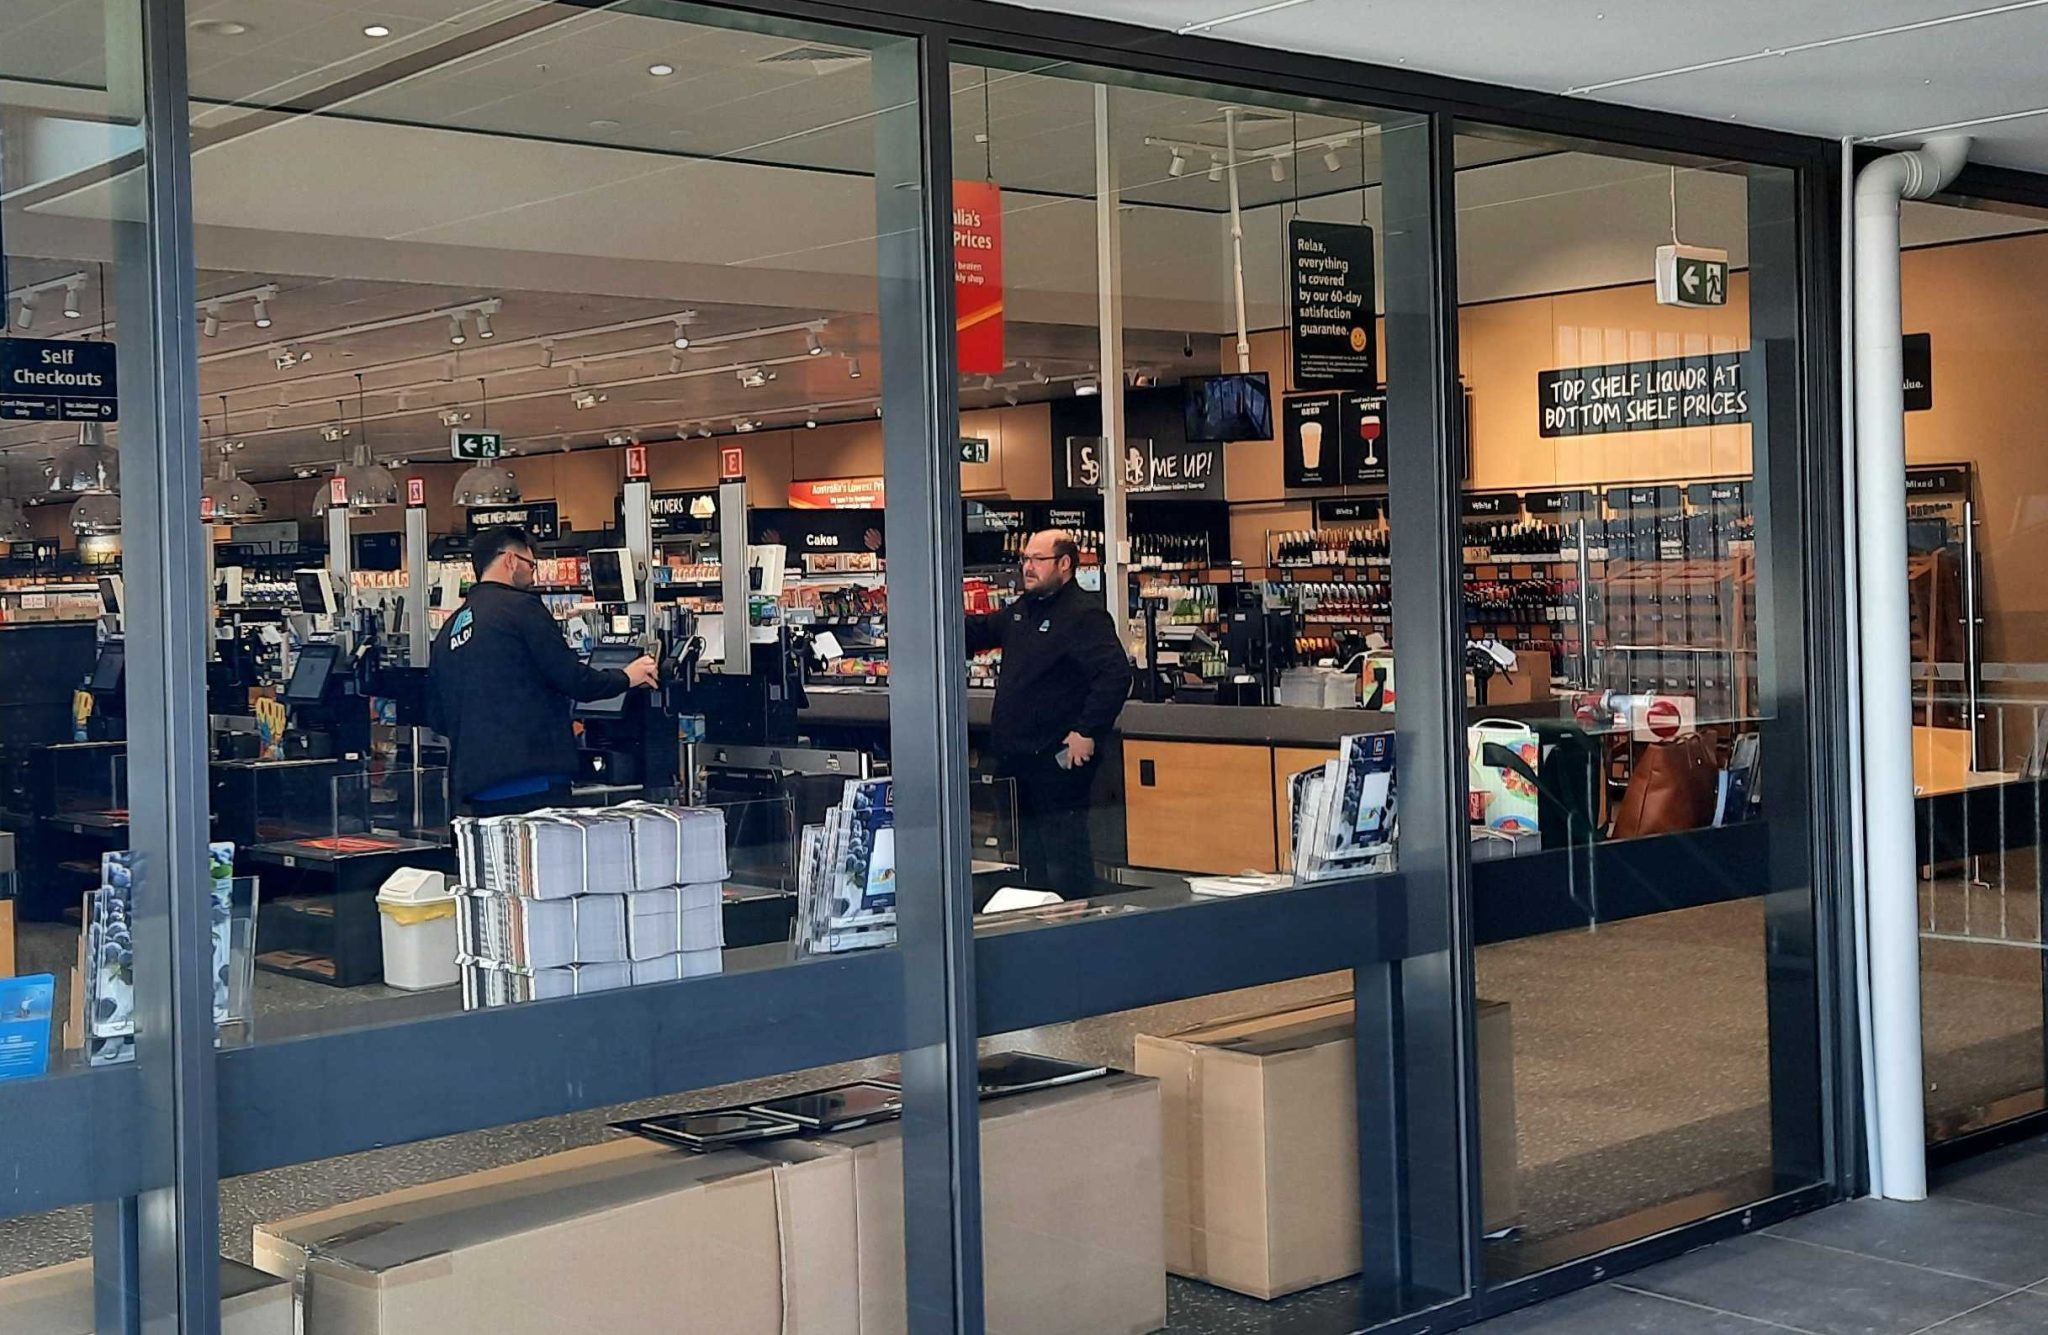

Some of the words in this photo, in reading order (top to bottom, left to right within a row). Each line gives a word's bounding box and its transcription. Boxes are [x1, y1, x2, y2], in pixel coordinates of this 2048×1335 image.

[953, 230, 992, 249] Prices
[1297, 238, 1327, 254] Relax,
[1298, 256, 1349, 273] everything
[967, 274, 985, 286] shop
[1298, 270, 1306, 284] is
[1308, 273, 1345, 286] covered
[1299, 287, 1311, 304] by
[1312, 292, 1329, 302] our
[1330, 290, 1362, 307] 60-day
[1299, 305, 1351, 319] satisfaction
[1300, 324, 1350, 337] guarantee.
[41, 348, 75, 365] Self
[13, 368, 103, 387] Checkouts
[1550, 380, 1585, 403] TOP
[1590, 373, 1641, 400] SHELF
[1646, 367, 1707, 394] LIQUOR
[1713, 364, 1740, 388] AT
[1545, 403, 1621, 429] BOTTOM
[1625, 398, 1678, 422] SHELF
[1683, 391, 1748, 417] PRICES
[1153, 455, 1178, 479] ME
[1184, 451, 1213, 479] UP!
[1547, 498, 1561, 508] Red
[806, 534, 838, 546] Cakes
